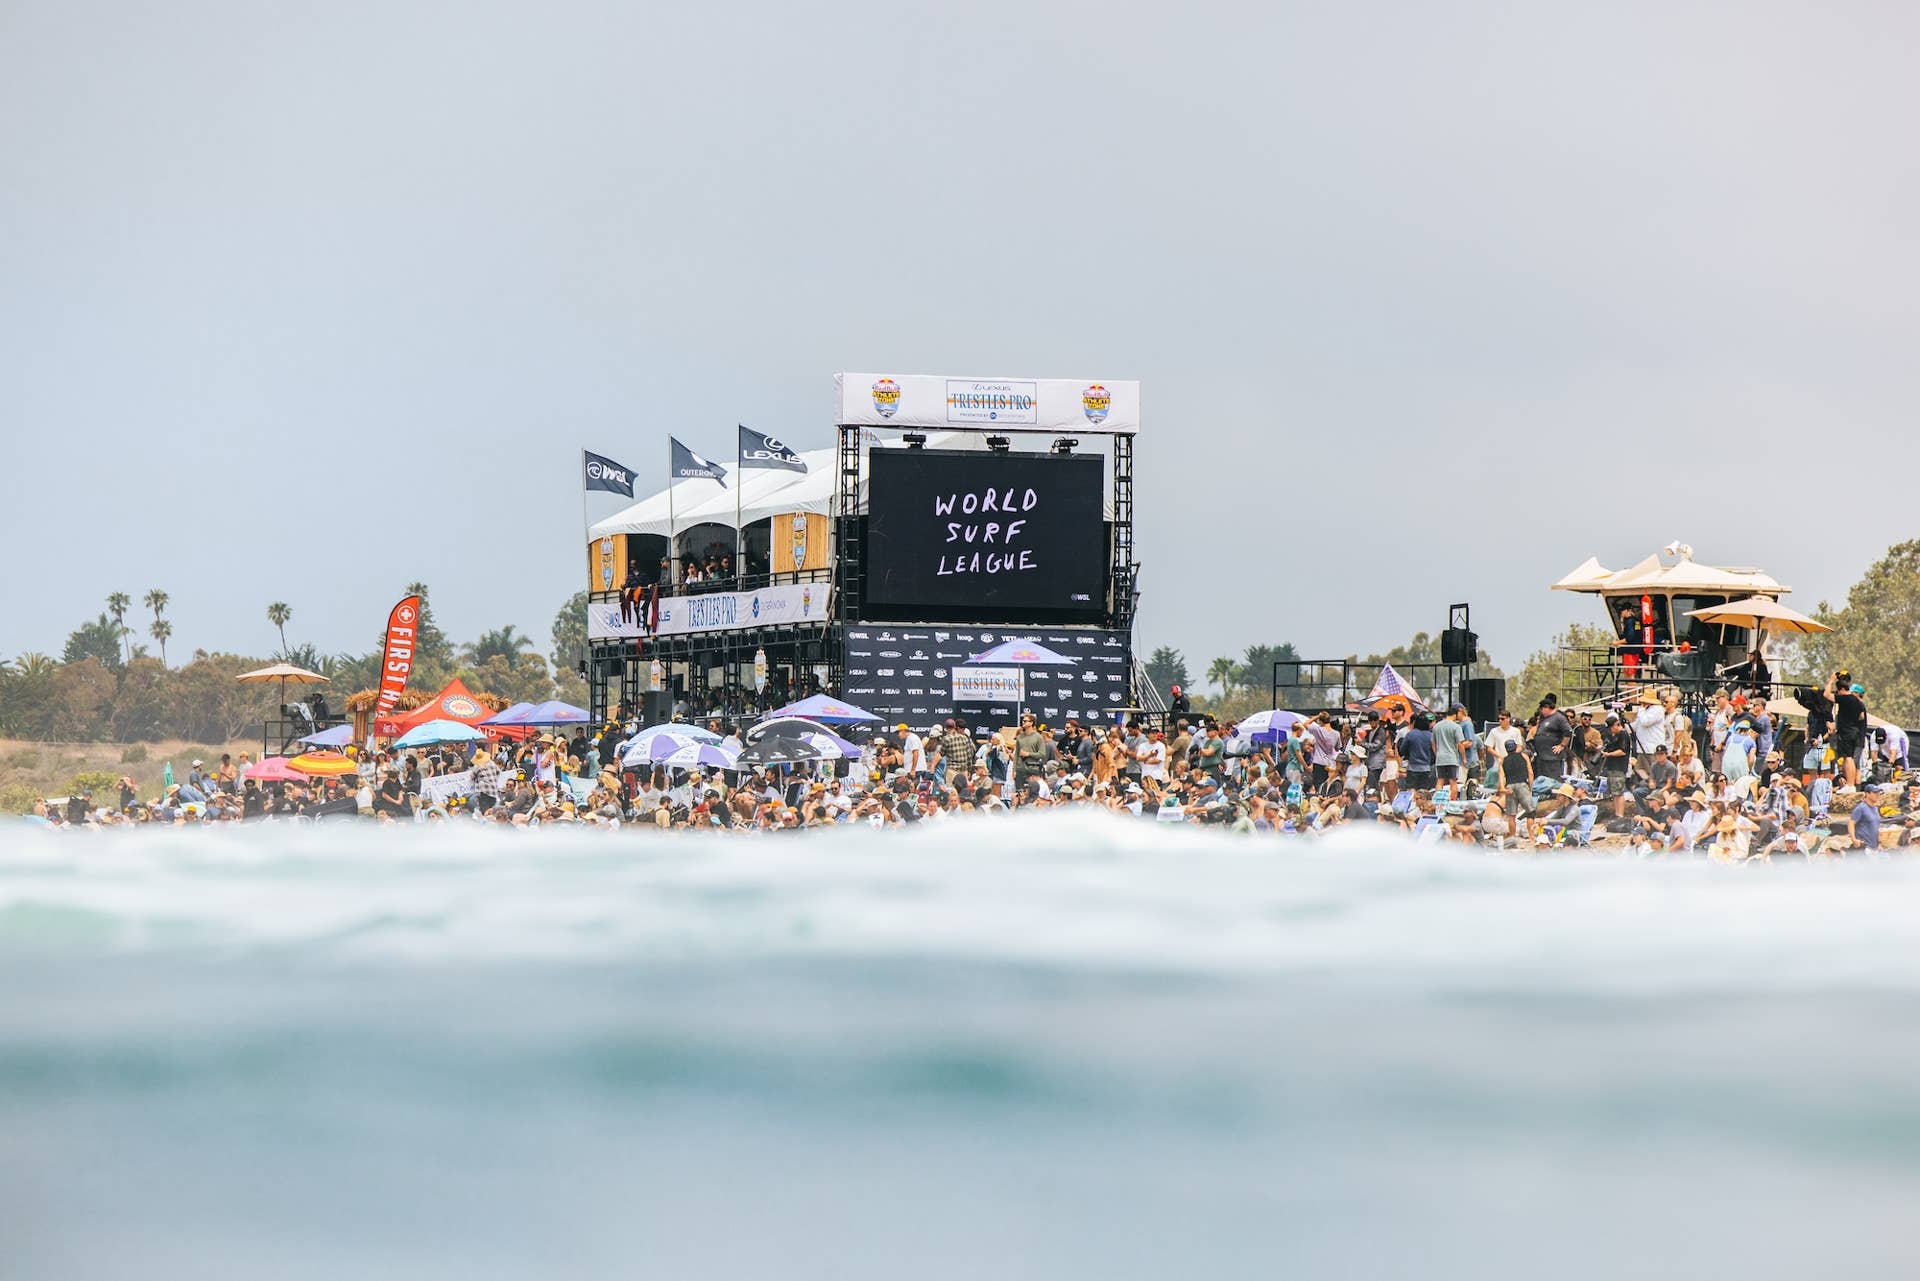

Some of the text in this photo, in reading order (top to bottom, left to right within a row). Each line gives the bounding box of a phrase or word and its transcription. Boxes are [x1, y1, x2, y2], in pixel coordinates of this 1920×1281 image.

[952, 393, 1031, 410] TRESTLES PRO
[743, 449, 804, 465] LEXUS
[603, 465, 630, 487] WSL
[936, 488, 1038, 516] WORLD
[946, 519, 1026, 544] SURF
[937, 549, 1038, 575] LEAGUE
[855, 632, 869, 640] WSL
[1081, 637, 1096, 645] WSL
[385, 626, 413, 686] FIRST
[910, 669, 924, 677] WSL
[956, 677, 1000, 691] TRESTLES
